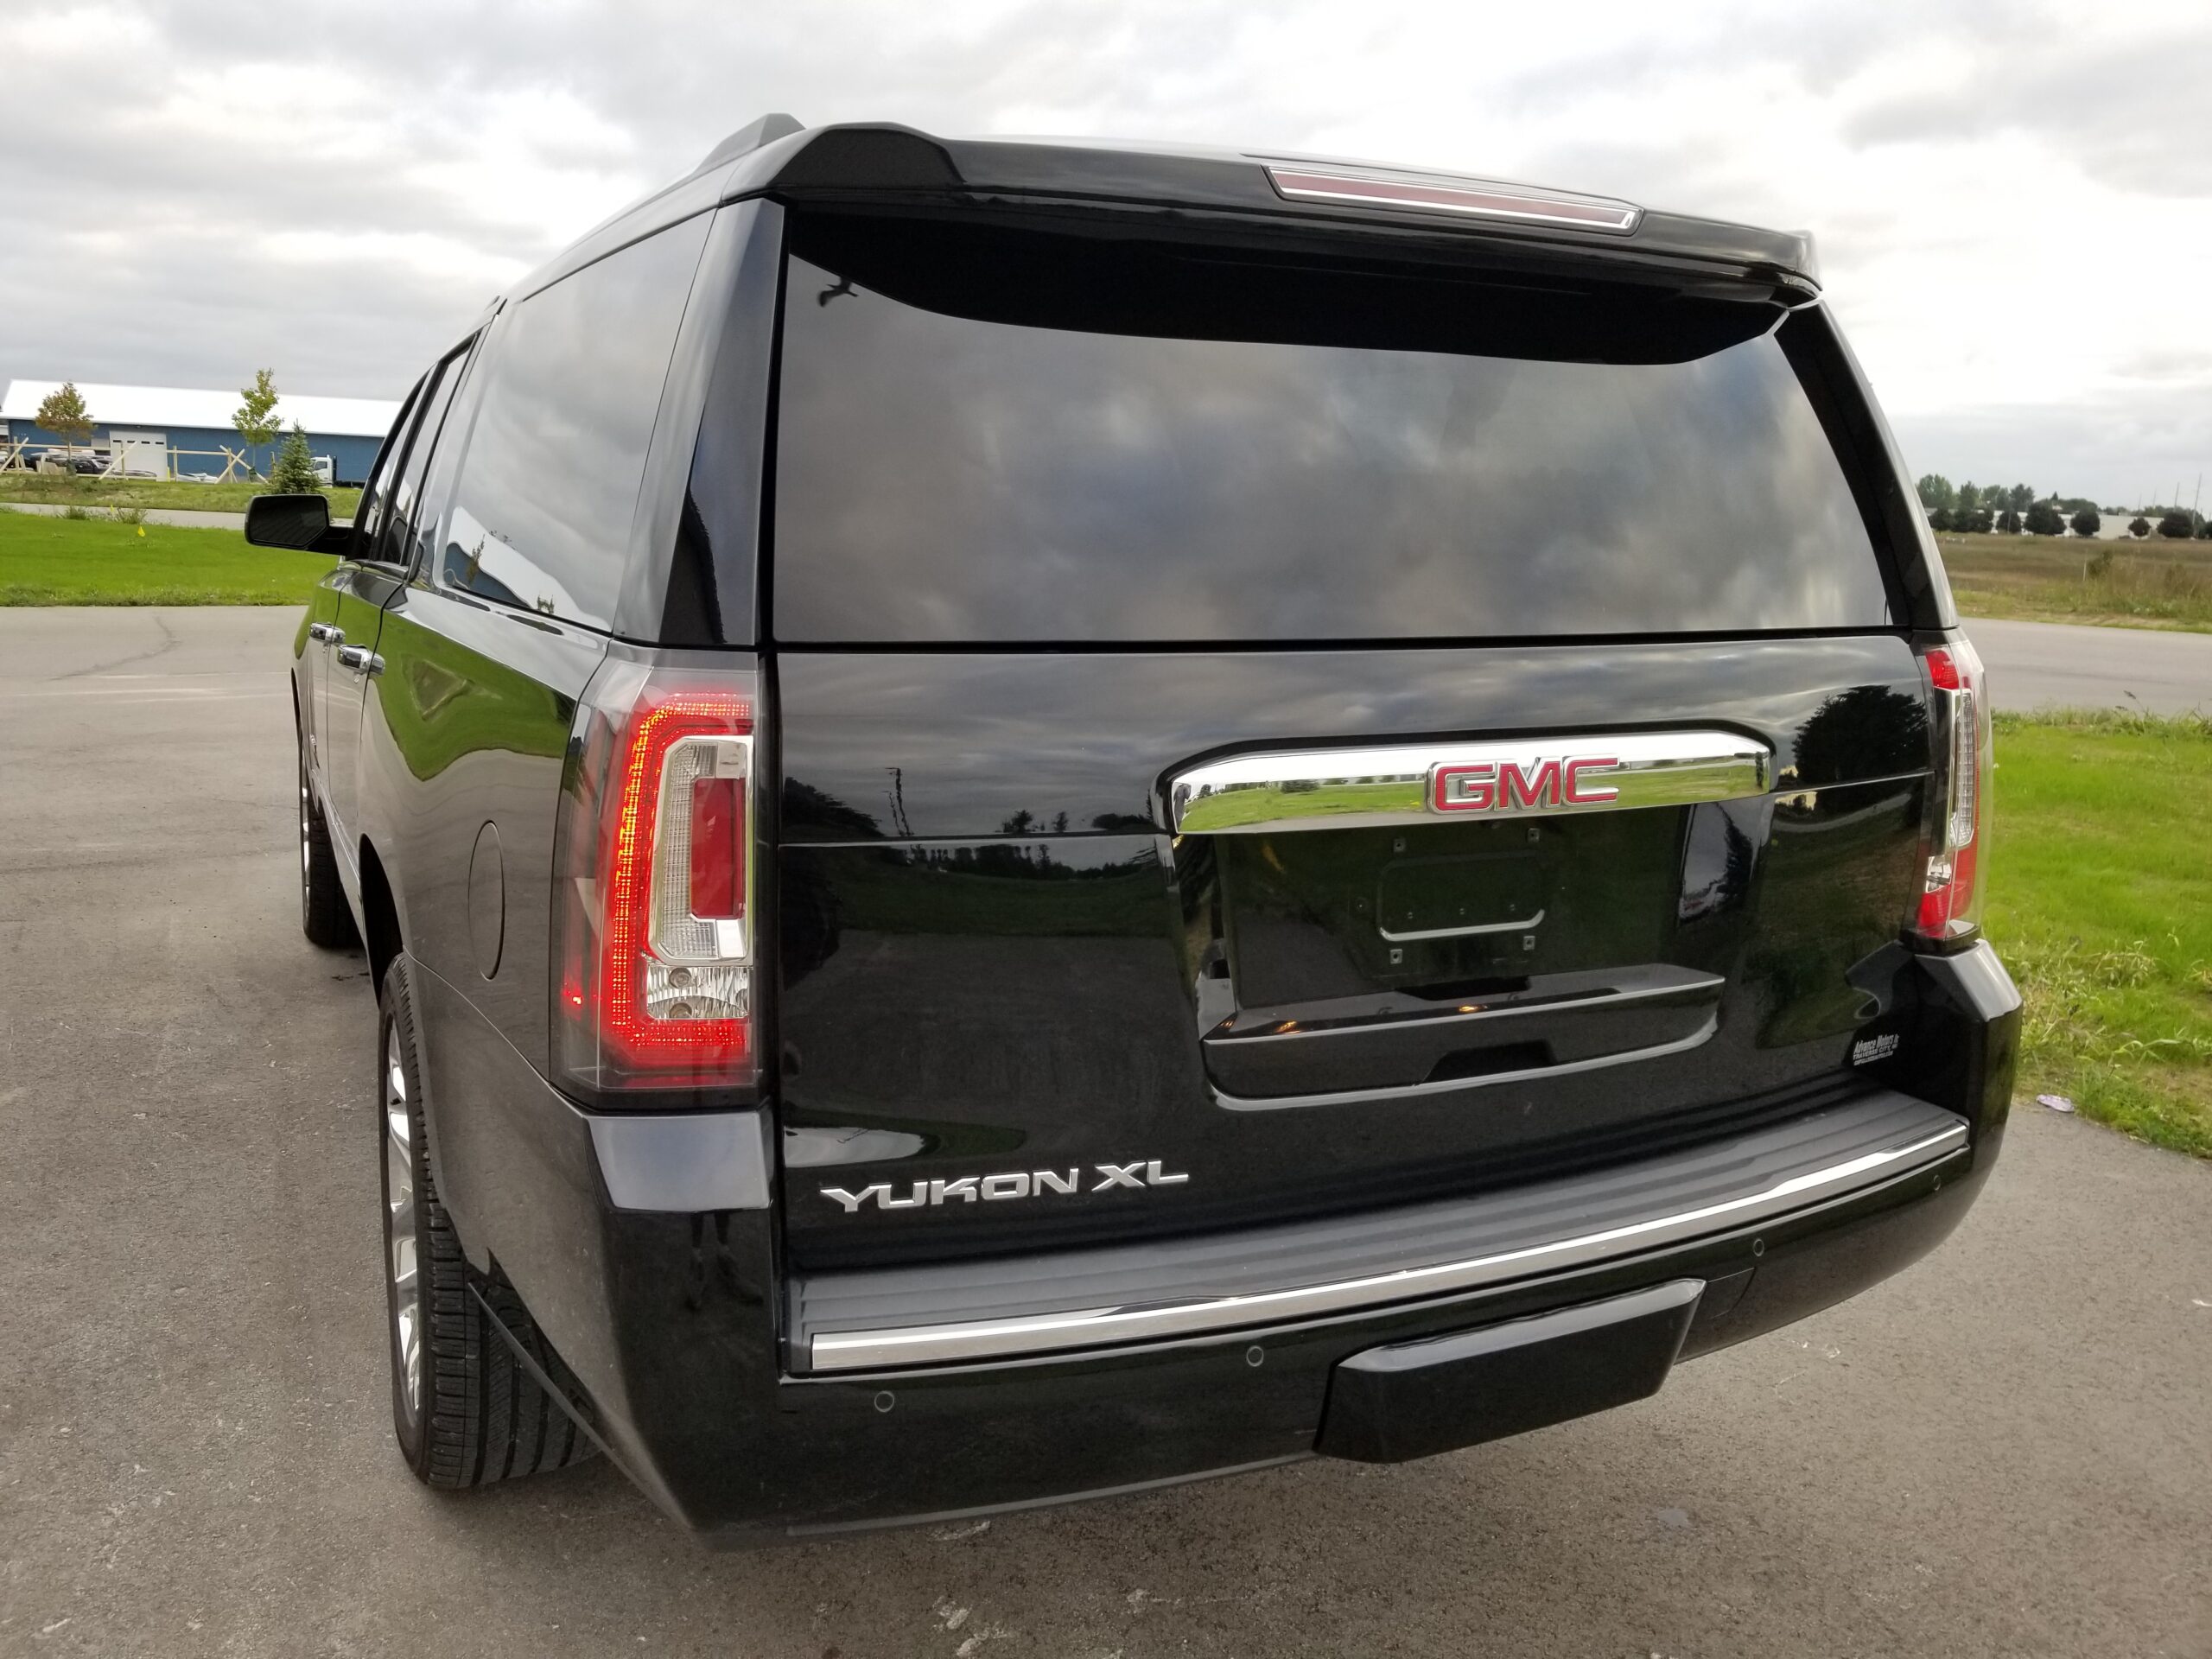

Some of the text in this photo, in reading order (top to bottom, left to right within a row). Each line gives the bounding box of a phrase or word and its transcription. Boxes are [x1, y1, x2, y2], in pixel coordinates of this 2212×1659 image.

[1427, 753, 1620, 815] GMC
[820, 1160, 1189, 1212] YUKON XL
